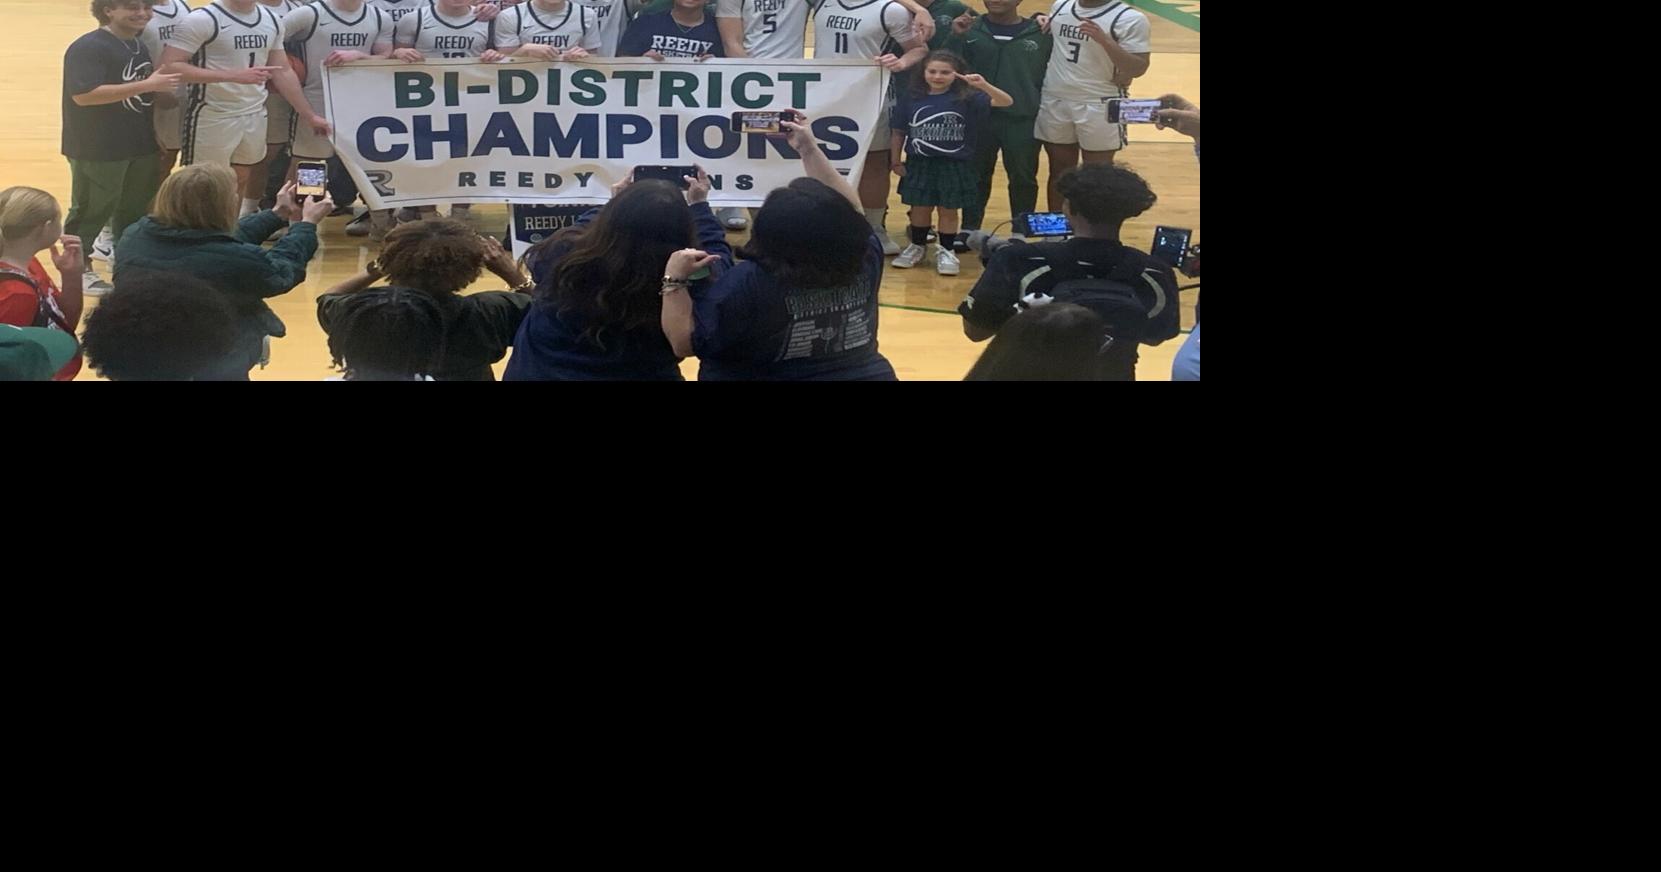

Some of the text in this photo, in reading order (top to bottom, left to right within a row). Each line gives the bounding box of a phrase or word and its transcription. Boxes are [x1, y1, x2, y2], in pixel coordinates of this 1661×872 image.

[762, 13, 777, 34] 5
[826, 15, 862, 31] REEDY
[233, 34, 268, 49] REEDY
[330, 33, 368, 47] REEDY
[434, 36, 475, 49] REEDY
[651, 35, 713, 54] REEDY
[834, 32, 848, 54] 11
[1065, 41, 1081, 64] 3
[394, 68, 822, 110] BI-DISTRICT
[458, 170, 595, 189] REEDY
[525, 215, 567, 230] REEDY
